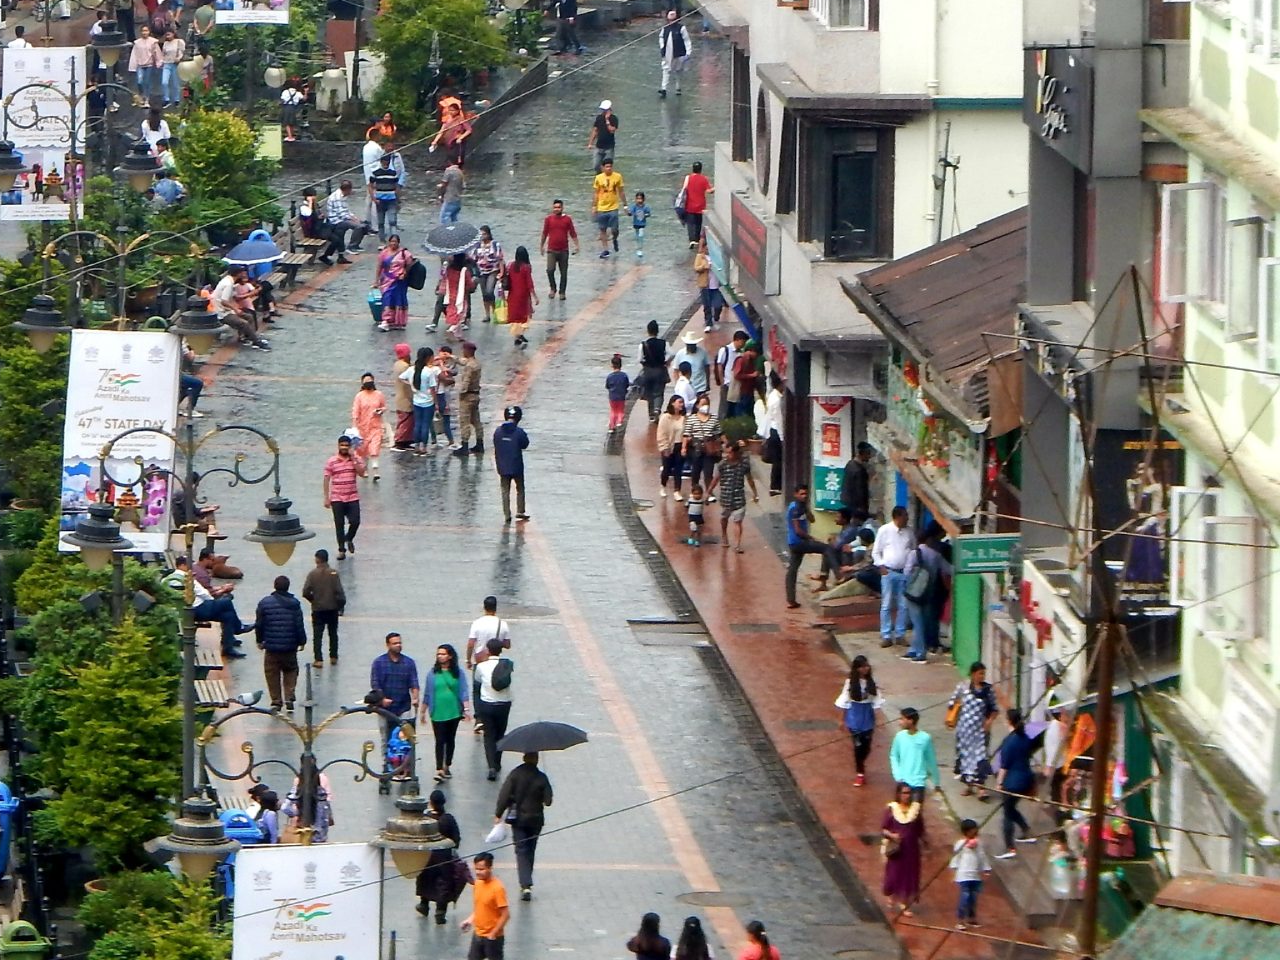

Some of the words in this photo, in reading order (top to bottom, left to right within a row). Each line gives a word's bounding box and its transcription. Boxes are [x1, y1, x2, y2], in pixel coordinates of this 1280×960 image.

[97, 384, 120, 392] Azadi
[104, 418, 140, 429] STATE
[143, 419, 167, 429] DAY
[274, 921, 304, 931] Azadi
[295, 931, 347, 943] Mahotsav
